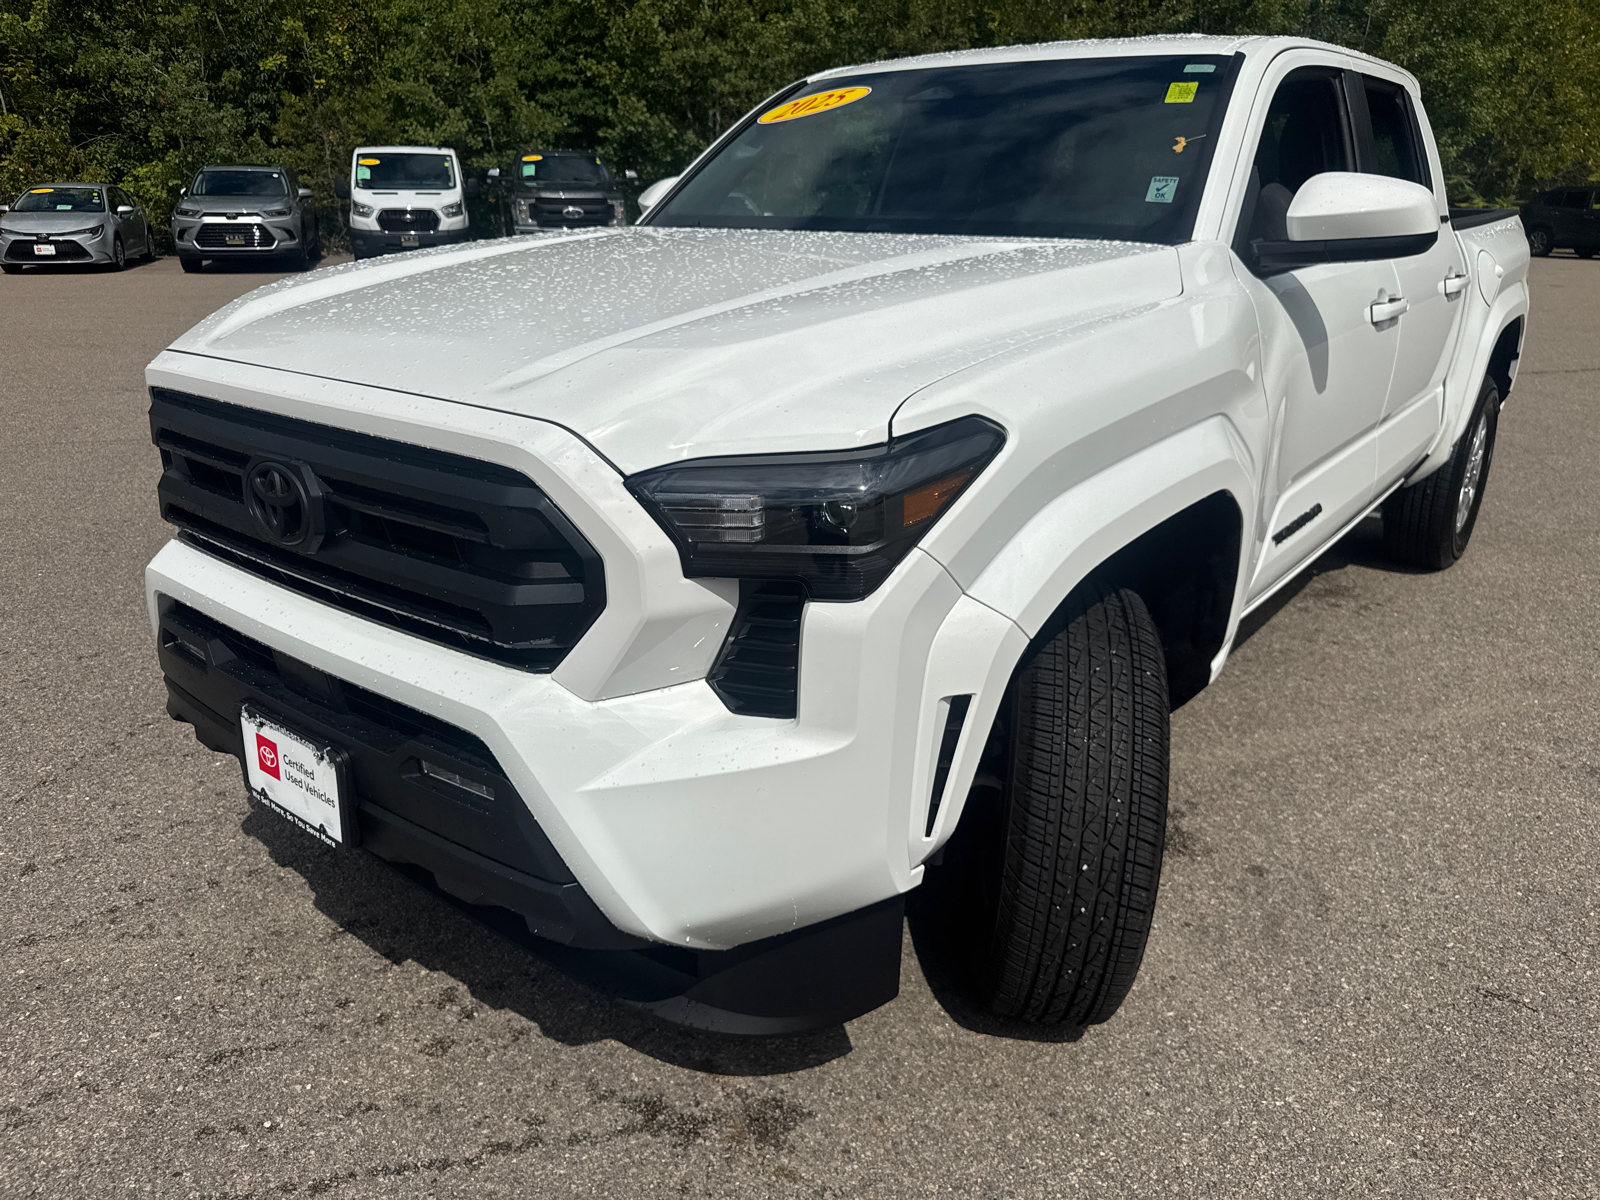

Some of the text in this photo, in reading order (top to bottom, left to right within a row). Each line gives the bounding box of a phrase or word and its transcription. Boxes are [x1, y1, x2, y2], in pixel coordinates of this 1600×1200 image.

[770, 89, 857, 121] 2025
[283, 754, 315, 780] Certified
[284, 769, 336, 809] Used Vehicles
[261, 795, 271, 808] Sell
[286, 811, 294, 822] So
[294, 816, 306, 829] You
[306, 823, 321, 839] Save
[320, 831, 337, 849] More
